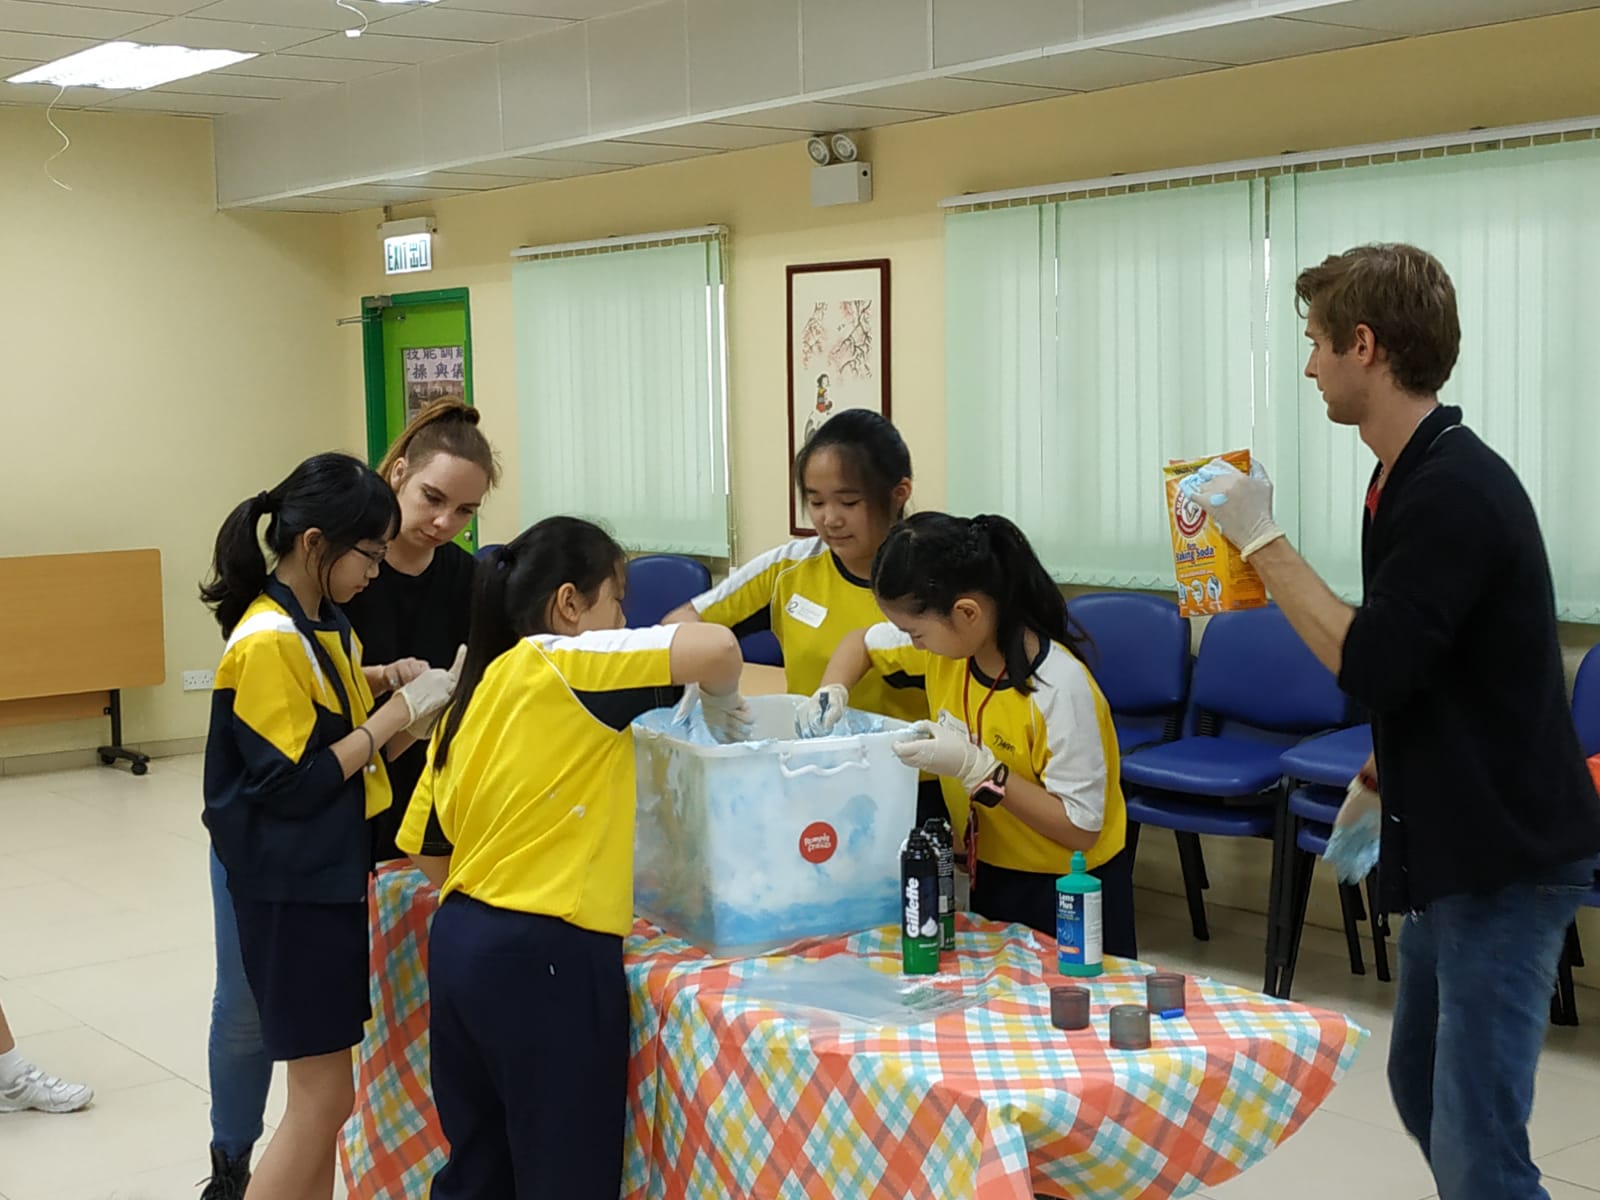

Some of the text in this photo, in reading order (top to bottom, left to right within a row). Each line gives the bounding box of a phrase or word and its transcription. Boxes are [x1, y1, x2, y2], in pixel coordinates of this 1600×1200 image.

[387, 242, 407, 271] EXIT
[409, 239, 428, 268] 出口
[1196, 545, 1214, 558] Soda
[787, 600, 800, 614] 2
[1058, 892, 1075, 902] Lens
[905, 876, 920, 939] Gillette
[1059, 901, 1074, 910] Plus
